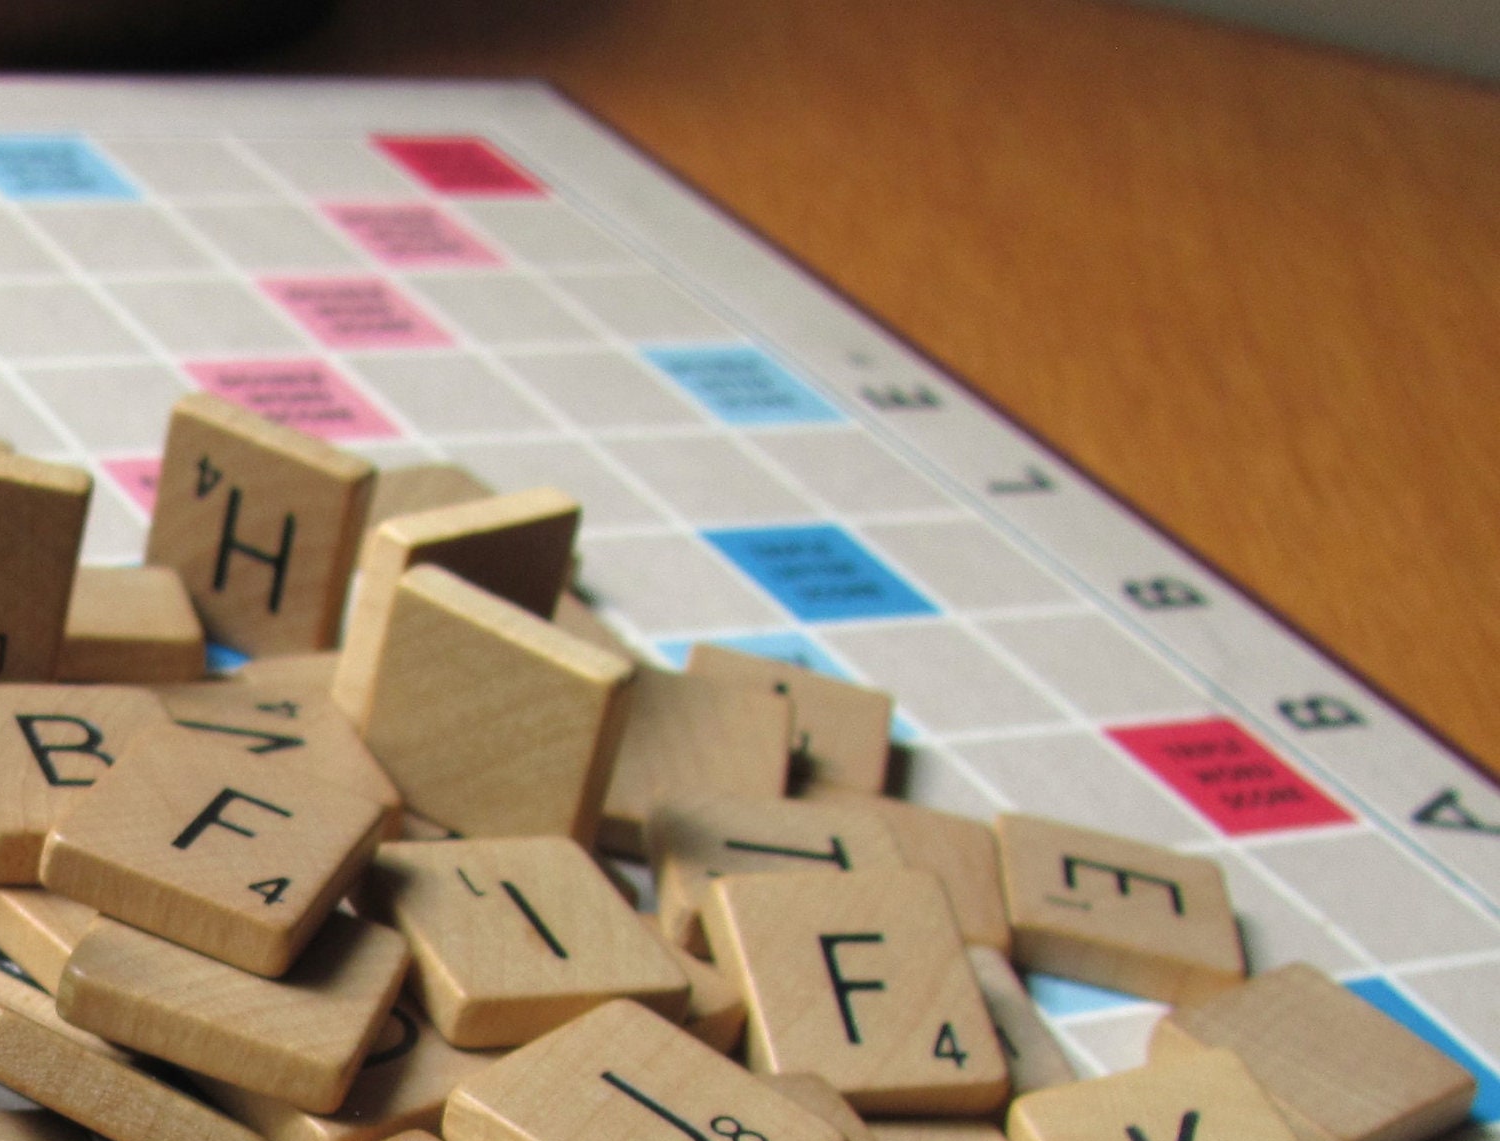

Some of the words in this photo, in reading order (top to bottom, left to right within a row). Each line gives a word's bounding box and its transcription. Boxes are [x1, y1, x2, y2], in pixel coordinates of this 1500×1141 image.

[214, 486, 297, 615] H
[171, 786, 294, 851] F
[1062, 855, 1186, 917] E
[819, 932, 886, 1046] F
